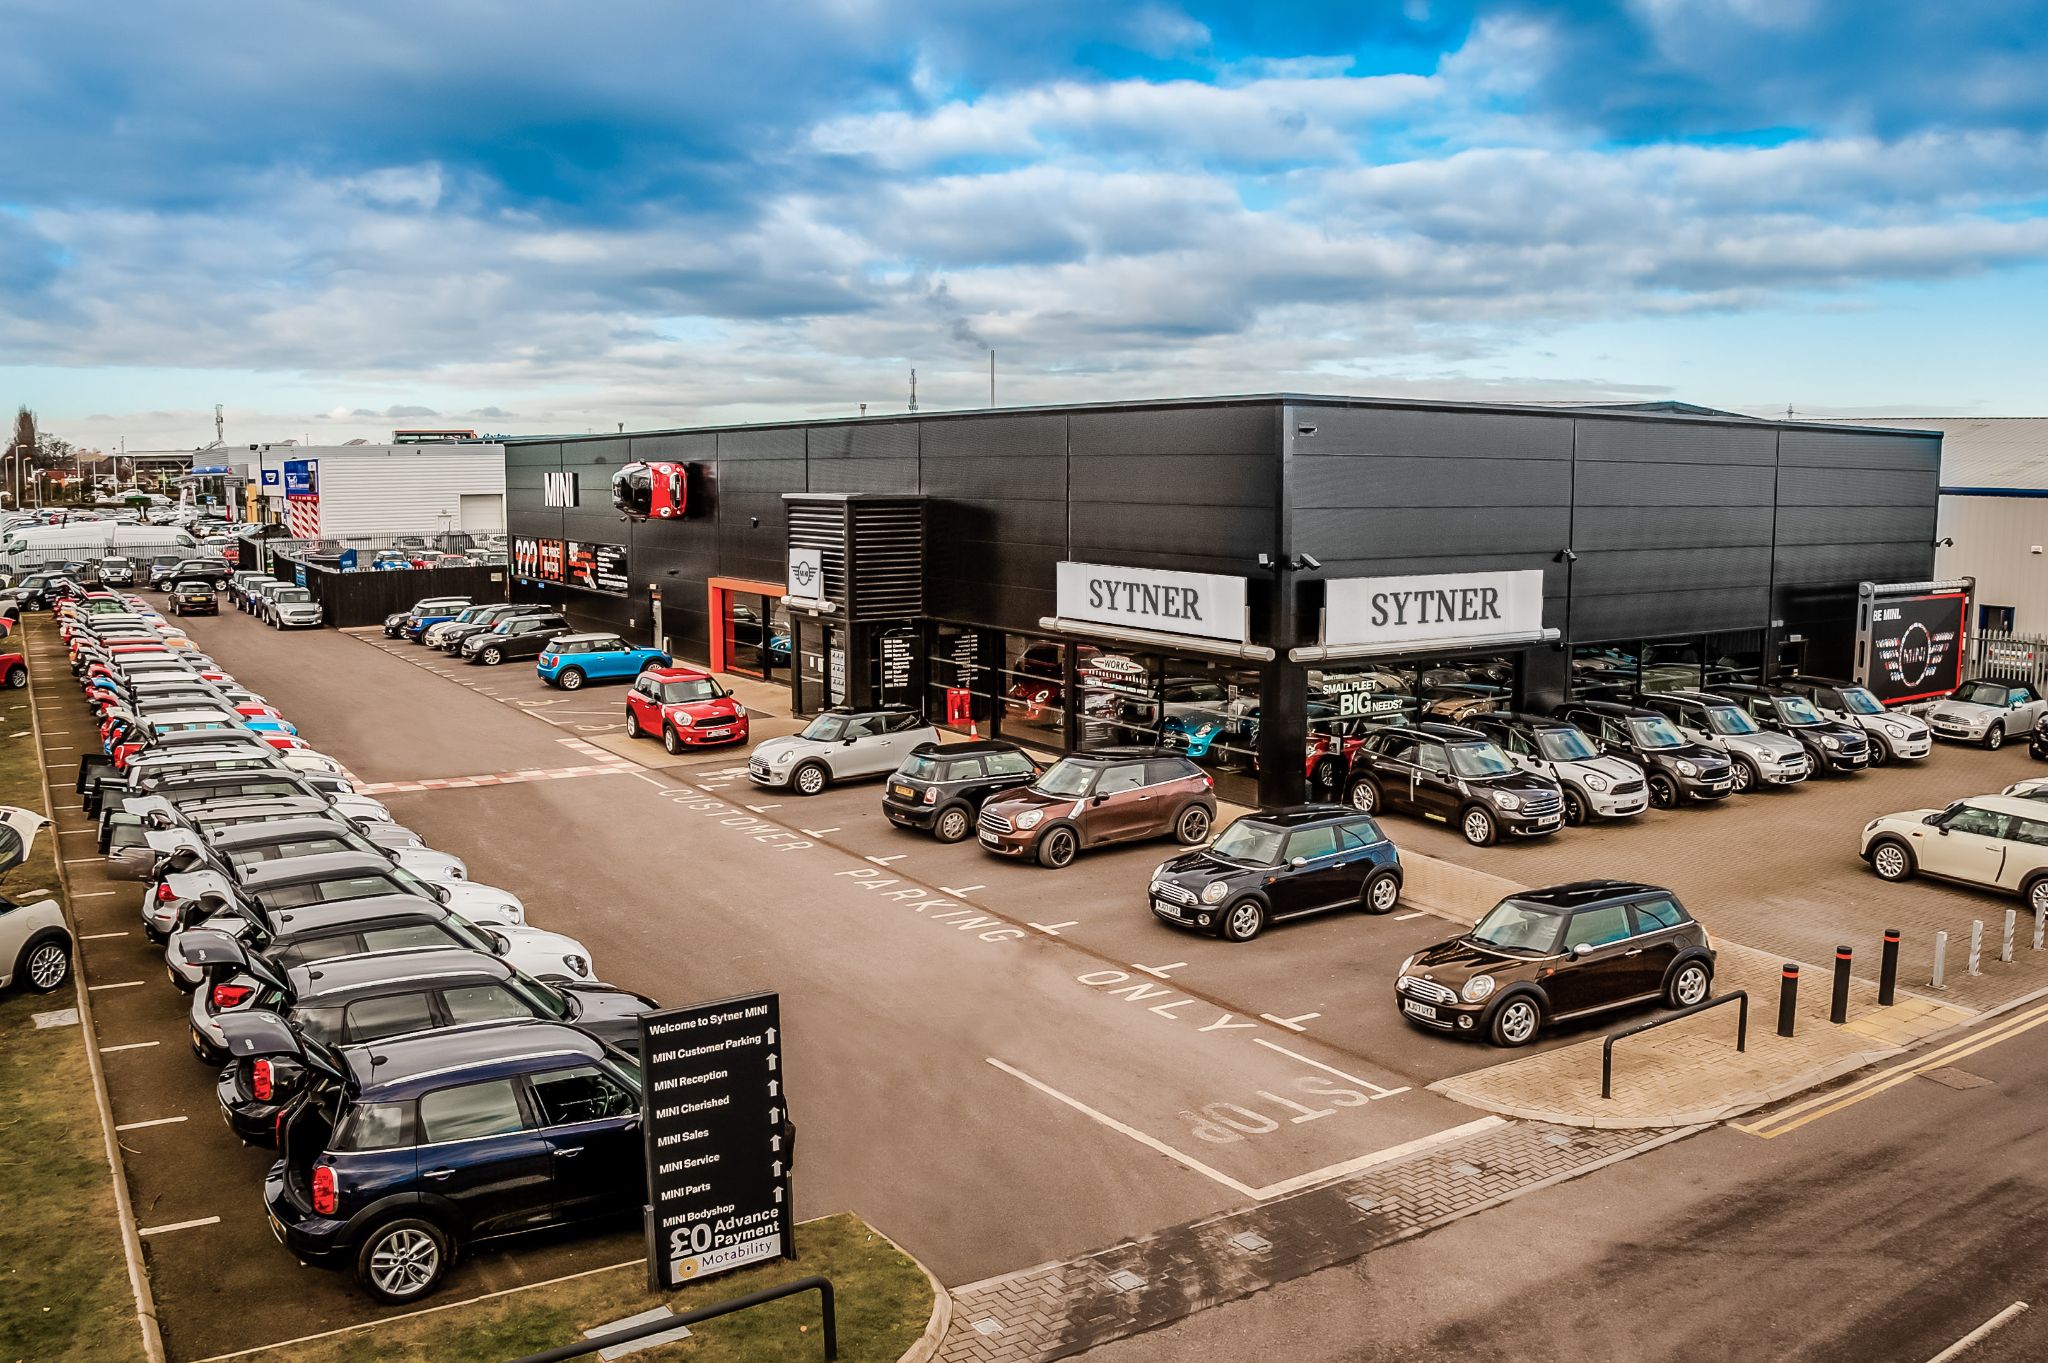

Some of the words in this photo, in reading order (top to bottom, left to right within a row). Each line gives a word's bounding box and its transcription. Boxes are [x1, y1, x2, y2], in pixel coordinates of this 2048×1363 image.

[543, 472, 574, 507] MINI
[1089, 578, 1203, 621] SYTNER
[1371, 587, 1502, 627] SYTNER
[1873, 609, 1882, 621] BE
[1104, 659, 1129, 671] WORKS
[1322, 682, 1351, 695] SMALL
[1352, 680, 1377, 692] FLEET
[1340, 691, 1372, 716] BIG
[1372, 699, 1403, 712] NEEDS?
[658, 788, 814, 852] CUSTOMER
[834, 867, 1025, 943] PARKING
[1077, 969, 1258, 1032] ONLY
[649, 1020, 697, 1036] Welcome
[697, 1017, 709, 1027] to
[709, 1011, 744, 1026] Sytner
[744, 1004, 768, 1018] MINI
[652, 1051, 676, 1064] MINI
[677, 1043, 725, 1059] Customer
[725, 1034, 762, 1049] Parking
[654, 1078, 678, 1092] MINI
[679, 1069, 728, 1087] Reception
[656, 1105, 680, 1120] MINI
[680, 1094, 730, 1114] Cherished
[1176, 1076, 1370, 1144] STOP
[657, 1133, 681, 1147] MINI
[682, 1129, 710, 1142] Sales
[659, 1160, 683, 1175] MINI
[683, 1154, 721, 1169] Service
[661, 1187, 684, 1201] MINI
[685, 1182, 711, 1196] Parts
[663, 1214, 686, 1228] MINI
[687, 1203, 735, 1222] Bodyshop
[670, 1223, 712, 1259] £0
[714, 1208, 779, 1233] Advance
[714, 1220, 780, 1248] Payment
[702, 1241, 772, 1267] Motability
